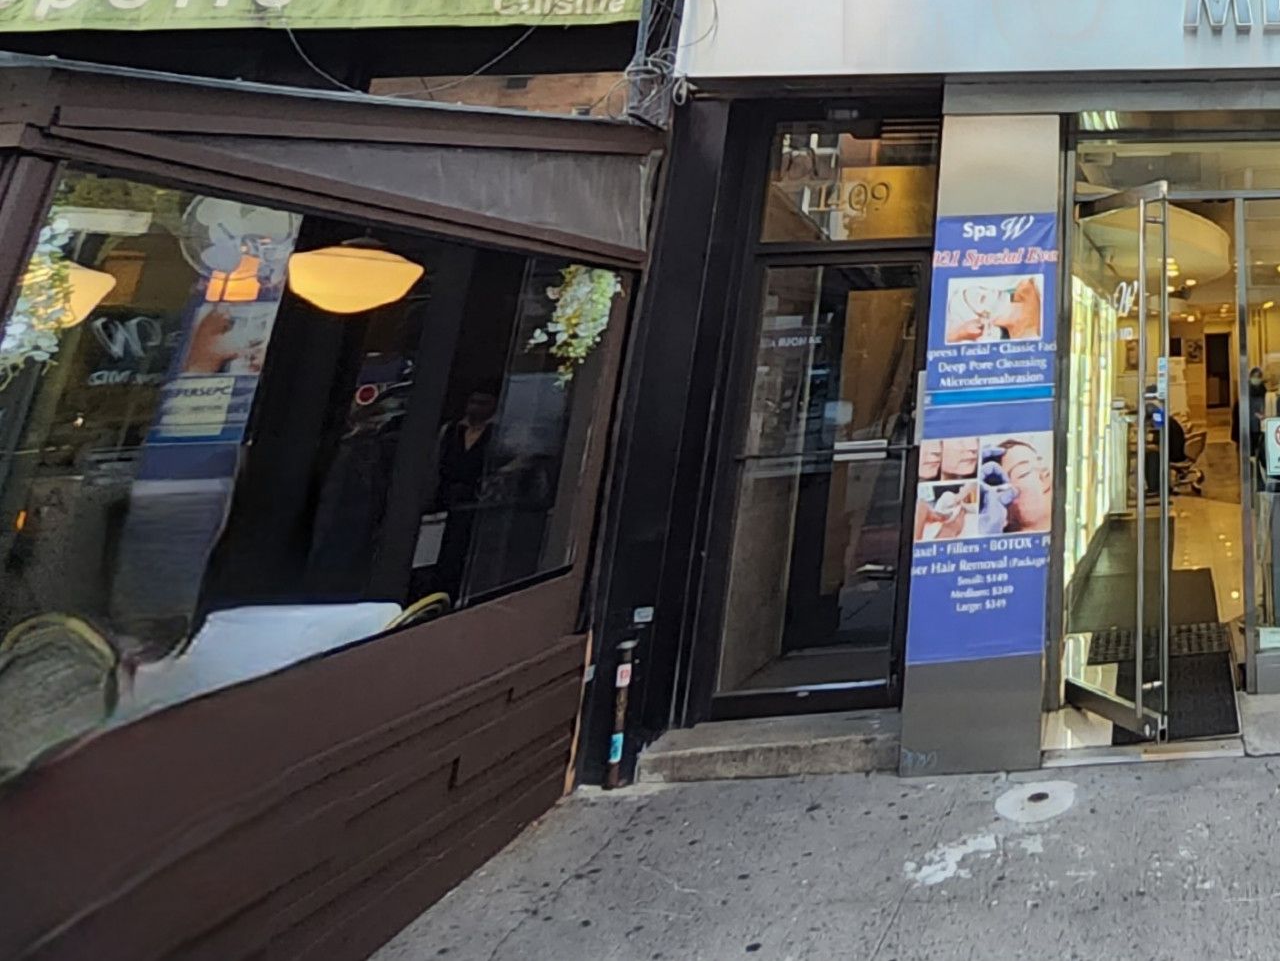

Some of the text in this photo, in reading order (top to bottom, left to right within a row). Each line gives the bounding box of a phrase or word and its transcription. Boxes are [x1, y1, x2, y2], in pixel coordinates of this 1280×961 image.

[963, 222, 996, 241] Spa
[962, 247, 1025, 270] Special
[961, 344, 990, 356] Facial
[999, 342, 1036, 354] Classic
[938, 357, 1047, 374] Deep Pore Cleansing
[939, 372, 1044, 386] Microdermabrasion
[947, 541, 979, 555] Fillers
[990, 537, 1032, 551] BOTOX
[931, 560, 955, 574] Hair
[959, 556, 1007, 571] Removal
